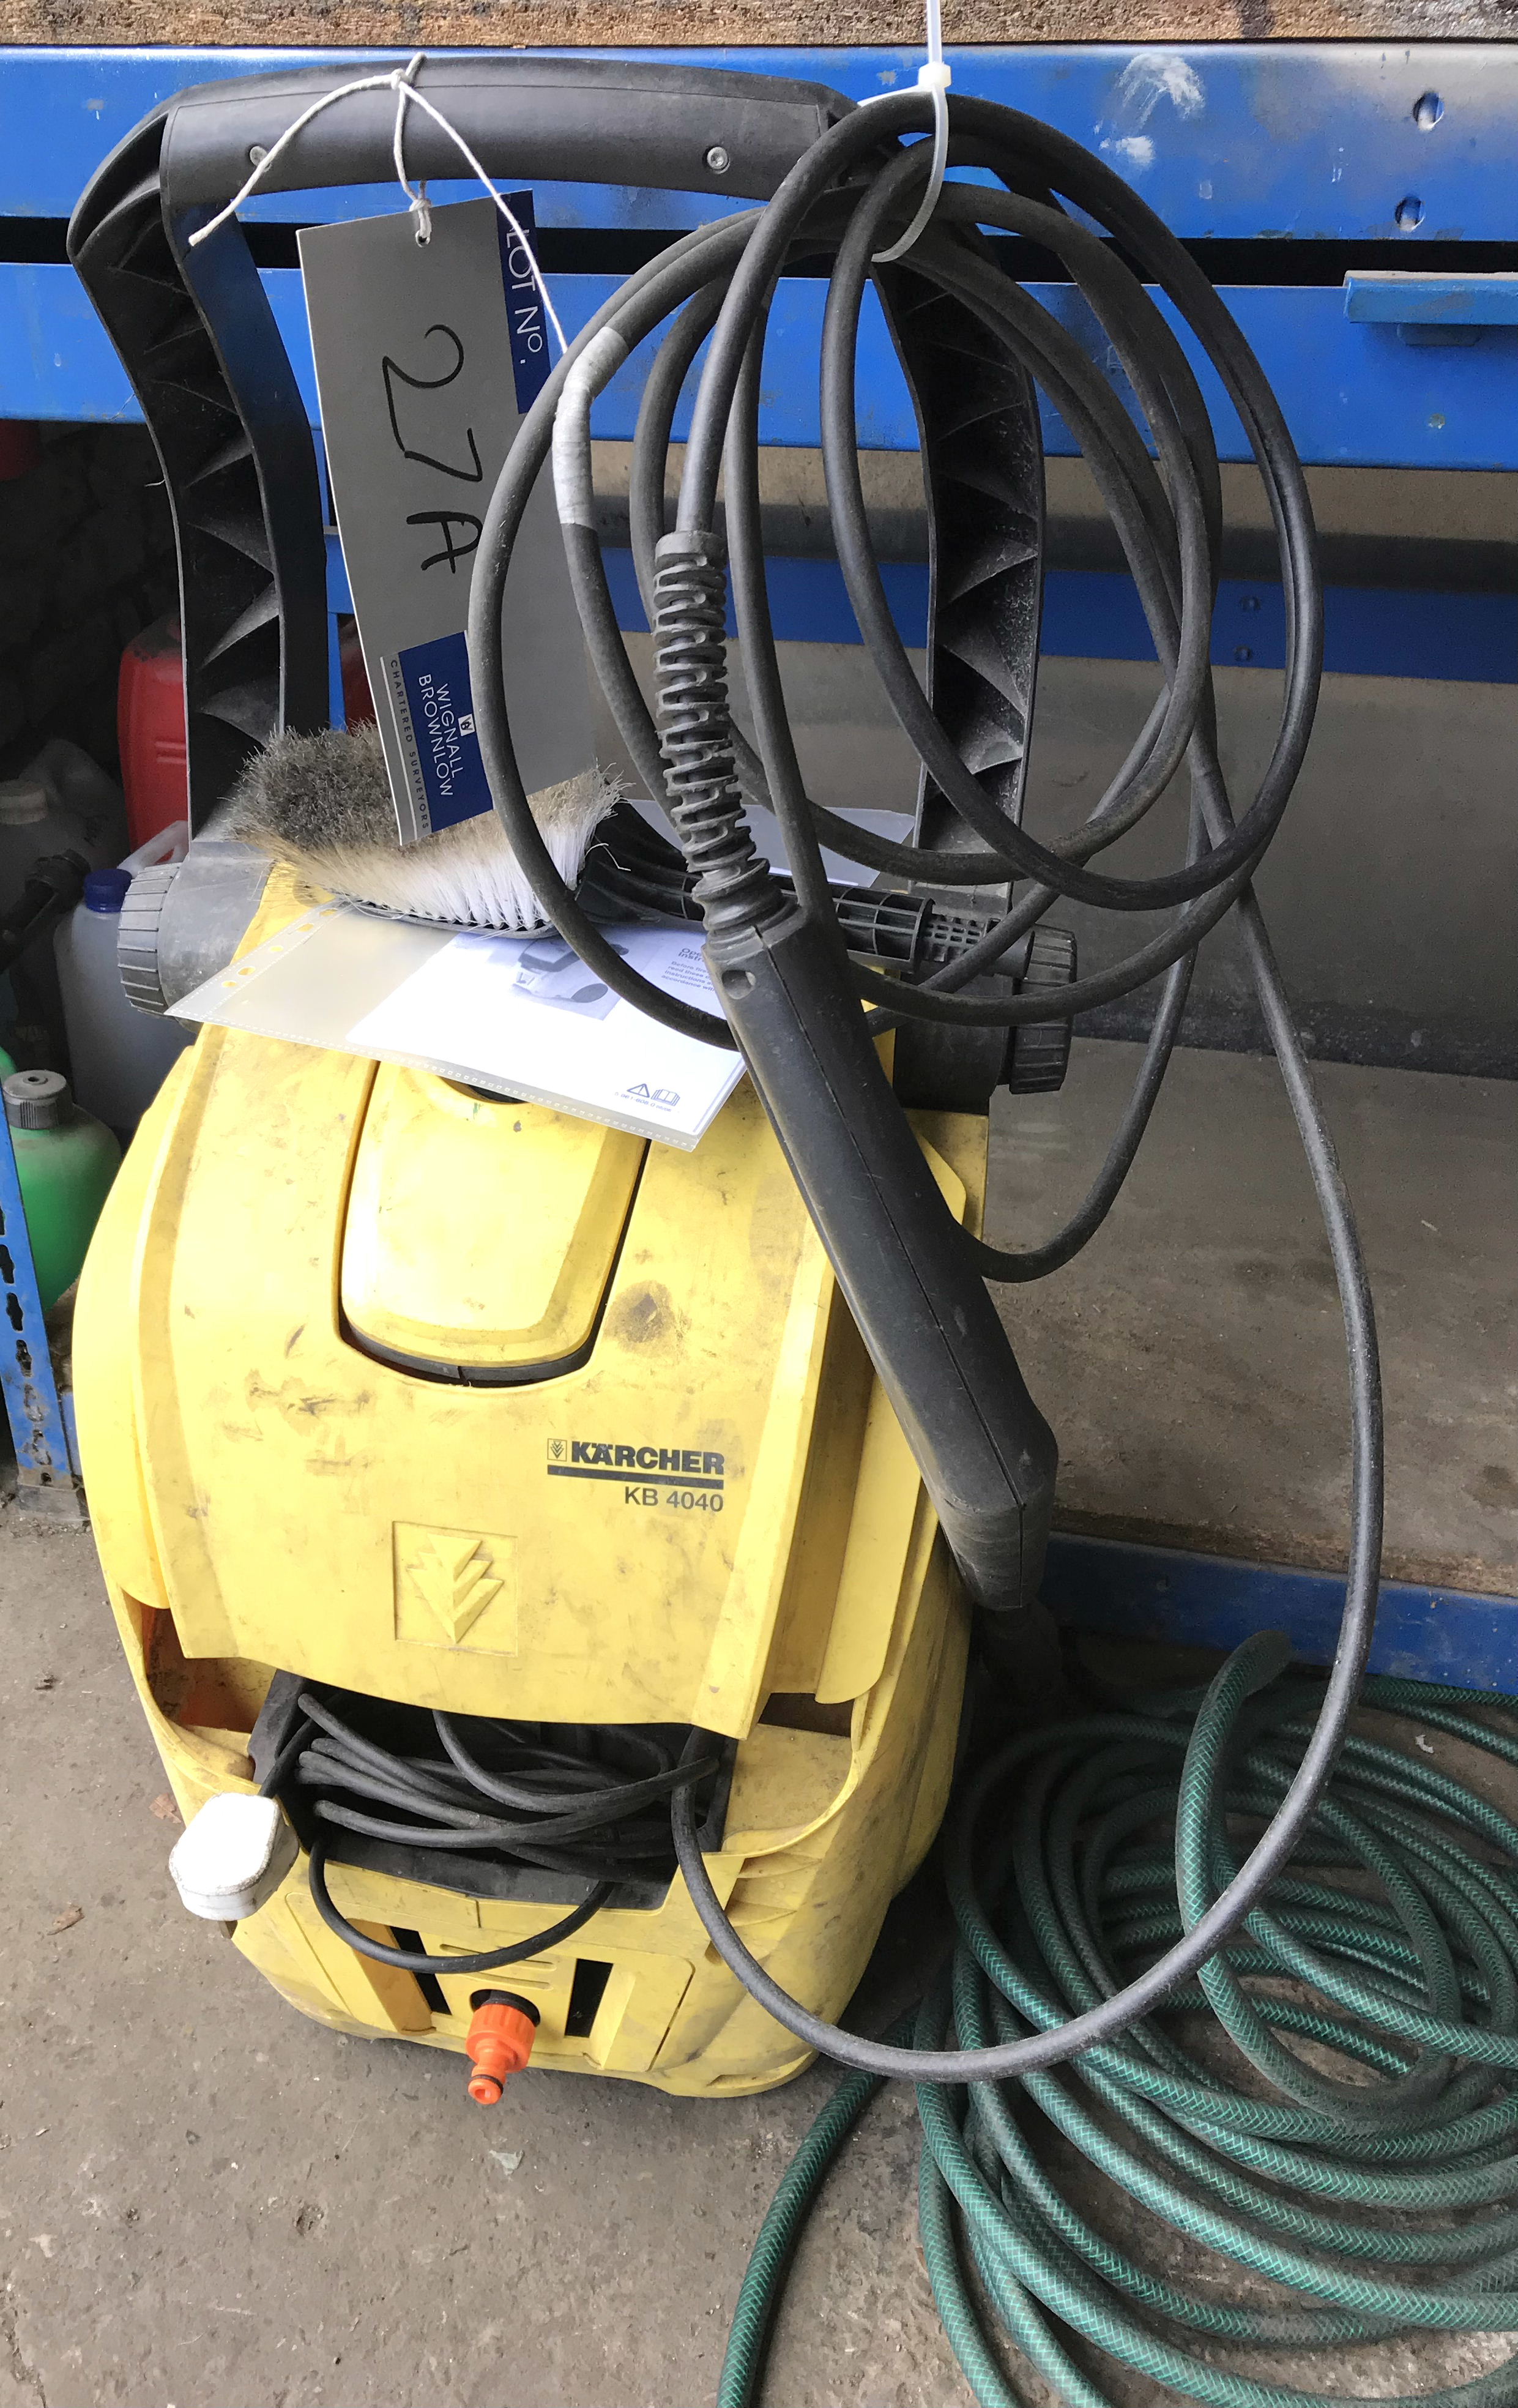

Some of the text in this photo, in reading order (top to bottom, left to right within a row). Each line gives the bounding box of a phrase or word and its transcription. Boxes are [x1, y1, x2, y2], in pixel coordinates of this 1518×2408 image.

[506, 228, 536, 291] LOT
[382, 324, 484, 574] 27A
[390, 659, 429, 829] CHARTERED SURVEYORS
[419, 674, 453, 796] BROWNLOW
[436, 683, 464, 778] WIGNALL
[661, 975, 701, 988] accordance
[664, 970, 705, 983] instructions
[671, 961, 694, 970] Before
[571, 1441, 726, 1475] KÄRCHER
[625, 1486, 724, 1512] KB 4040
